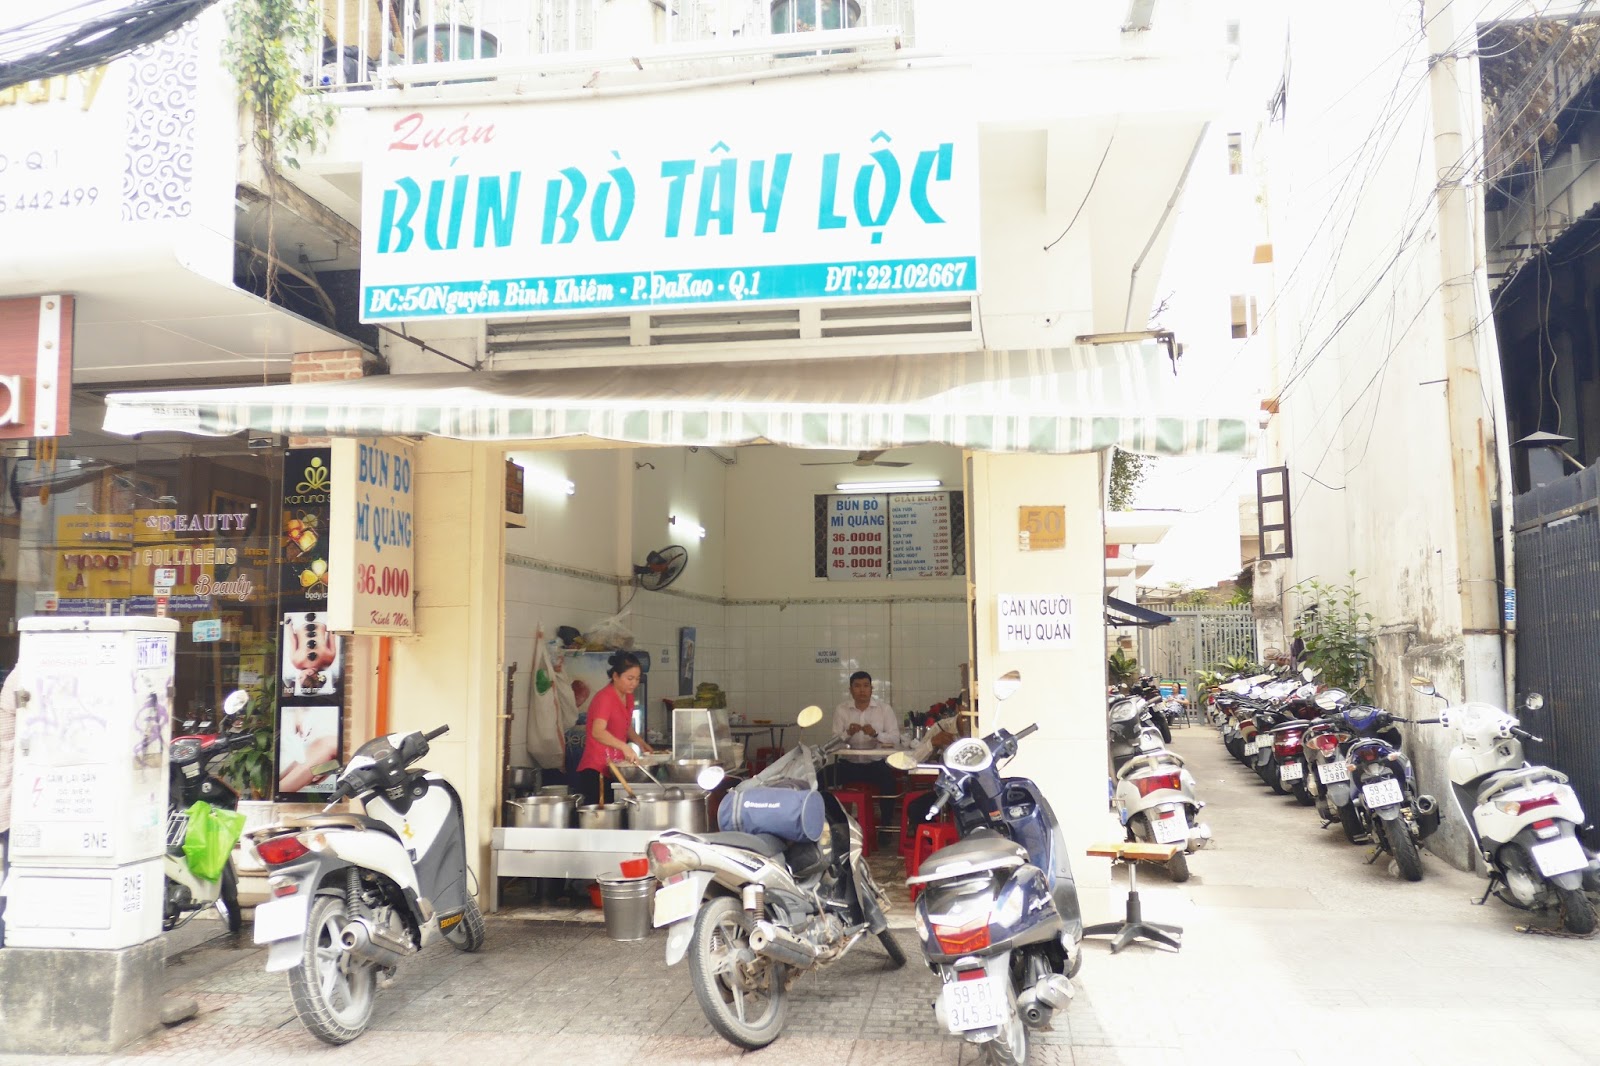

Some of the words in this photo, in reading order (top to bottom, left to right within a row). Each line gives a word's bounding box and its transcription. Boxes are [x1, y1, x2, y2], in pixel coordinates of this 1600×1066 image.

[387, 112, 496, 151] Quán
[377, 156, 522, 254] BÚN
[540, 150, 636, 245] BÒ
[661, 140, 793, 238] TÂY
[817, 129, 954, 245] LỘC
[552, 278, 614, 304] Khiêm
[358, 439, 390, 488] BÚN
[393, 447, 411, 494] BÒ
[836, 497, 859, 511] BÚN
[863, 496, 878, 511] BÒ
[356, 493, 370, 542] MÌ
[373, 496, 412, 553] QUẢNG
[831, 513, 844, 527] MÌ
[847, 511, 885, 528] QUẢNG
[1026, 511, 1061, 534] 50
[142, 547, 237, 566] COLLAGENS
[194, 573, 253, 602] Beauty
[357, 563, 410, 598] 36.000
[1030, 594, 1072, 615] NGƯỜI
[1007, 624, 1031, 645] PHỤ
[1036, 619, 1071, 641] QUÁN
[440, 913, 463, 929] HONDA
